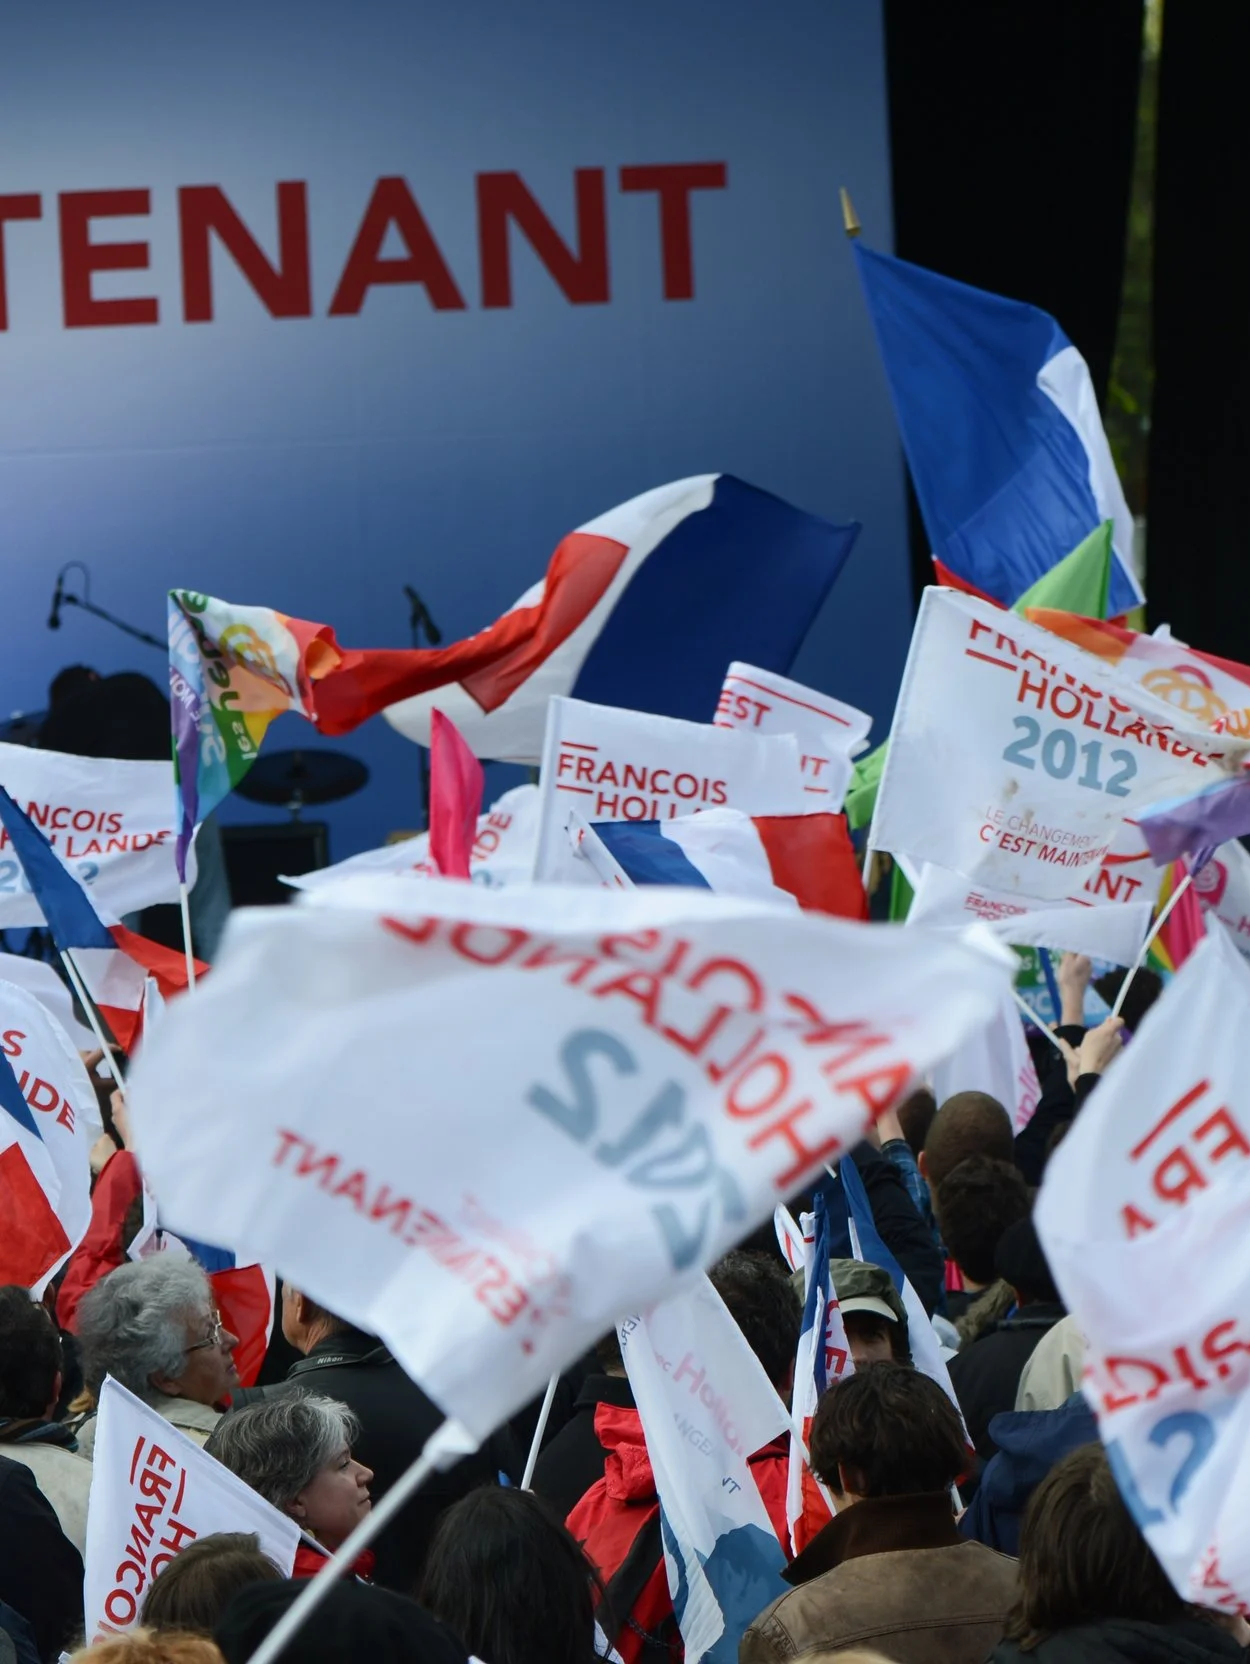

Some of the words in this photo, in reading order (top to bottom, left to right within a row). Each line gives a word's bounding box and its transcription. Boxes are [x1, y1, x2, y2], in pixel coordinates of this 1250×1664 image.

[1002, 715, 1139, 799] 2012
[557, 753, 728, 804] FRANÇOIS
[12, 799, 124, 833] NÇOIS
[979, 824, 1039, 857] C'EST
[317, 1356, 344, 1365] Nikon
